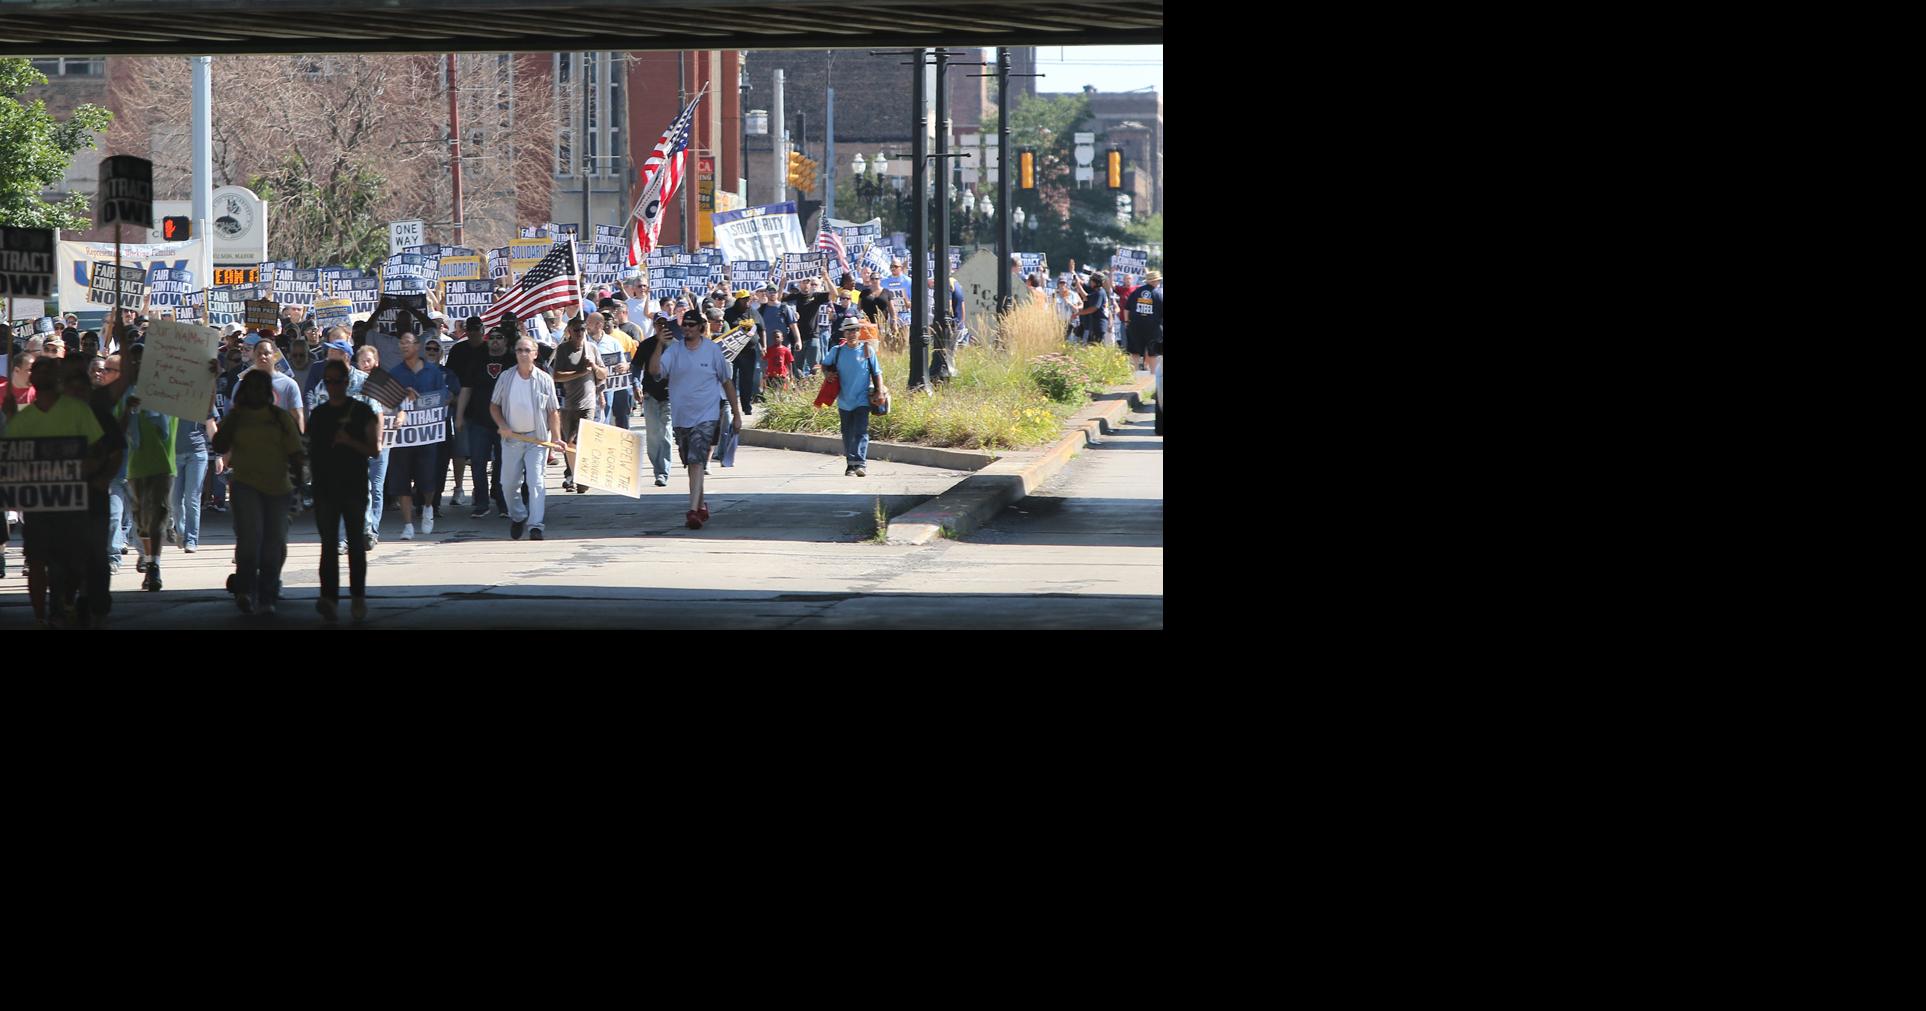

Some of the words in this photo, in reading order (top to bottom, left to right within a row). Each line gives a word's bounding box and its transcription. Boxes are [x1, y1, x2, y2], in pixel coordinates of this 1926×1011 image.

[396, 224, 417, 235] ONE
[596, 226, 609, 236] FAIR
[731, 216, 784, 236] SOLIDARITY
[846, 227, 859, 236] FAIR
[396, 236, 419, 246] WAY
[846, 235, 874, 245] CONTRACT
[388, 255, 402, 267] FAIR
[586, 254, 600, 263] FAIR
[646, 257, 673, 268] CONTRA
[677, 254, 691, 265] FAIR
[784, 254, 801, 264] FAIR
[386, 265, 423, 276] CONTRACT
[440, 263, 479, 277] OLIDARITY
[732, 262, 748, 272] FAIR
[785, 260, 822, 272] CONTRACT
[1116, 265, 1147, 276] NOW!
[153, 269, 170, 281] FAIR
[275, 269, 294, 280] FAIR
[650, 269, 664, 280] FAIR
[732, 271, 769, 281] CONTRACT
[785, 269, 822, 281] NOW!
[93, 277, 144, 293] CONRACT
[273, 281, 318, 292] CONTRACT
[333, 280, 352, 290] FAIR
[384, 280, 402, 291] FAIR
[446, 281, 467, 292] FAIR
[650, 279, 686, 290] CONTRACT
[687, 276, 709, 286] TRACT
[150, 281, 193, 293] CONTRACT
[208, 290, 229, 303] FAIR
[446, 293, 493, 304] CONTRACT
[207, 302, 246, 313] CONTRA
[1136, 303, 1153, 314] STEEL
[404, 407, 444, 428] NTRACT
[0, 440, 36, 460] FAIR
[0, 459, 82, 481] CONTRACT
[0, 485, 83, 507] NOW!
